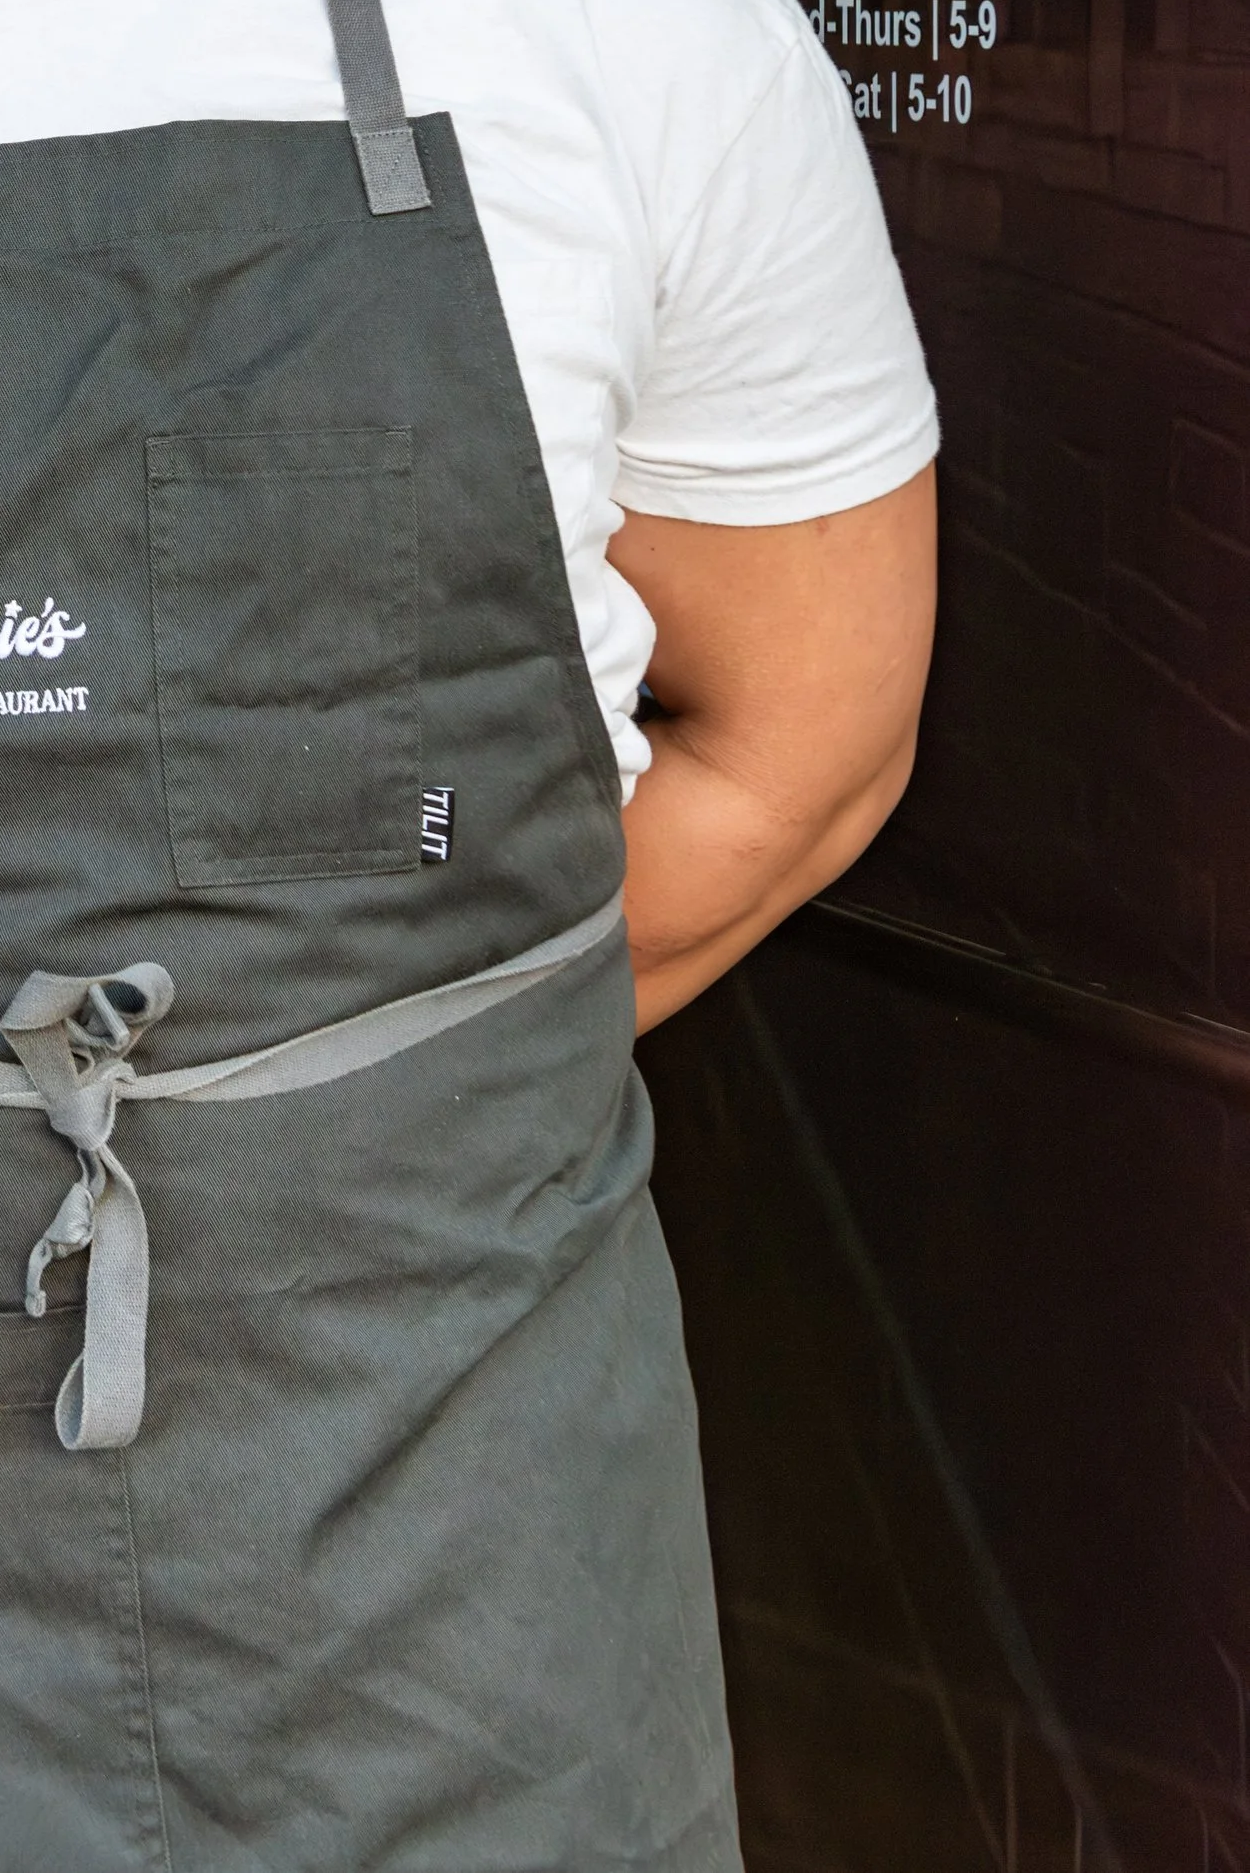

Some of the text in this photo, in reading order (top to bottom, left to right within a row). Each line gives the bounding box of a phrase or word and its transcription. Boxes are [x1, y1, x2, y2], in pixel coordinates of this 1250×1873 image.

[949, 0, 997, 50] 5-9
[907, 73, 972, 125] 5-10
[421, 791, 449, 861] TILIT
